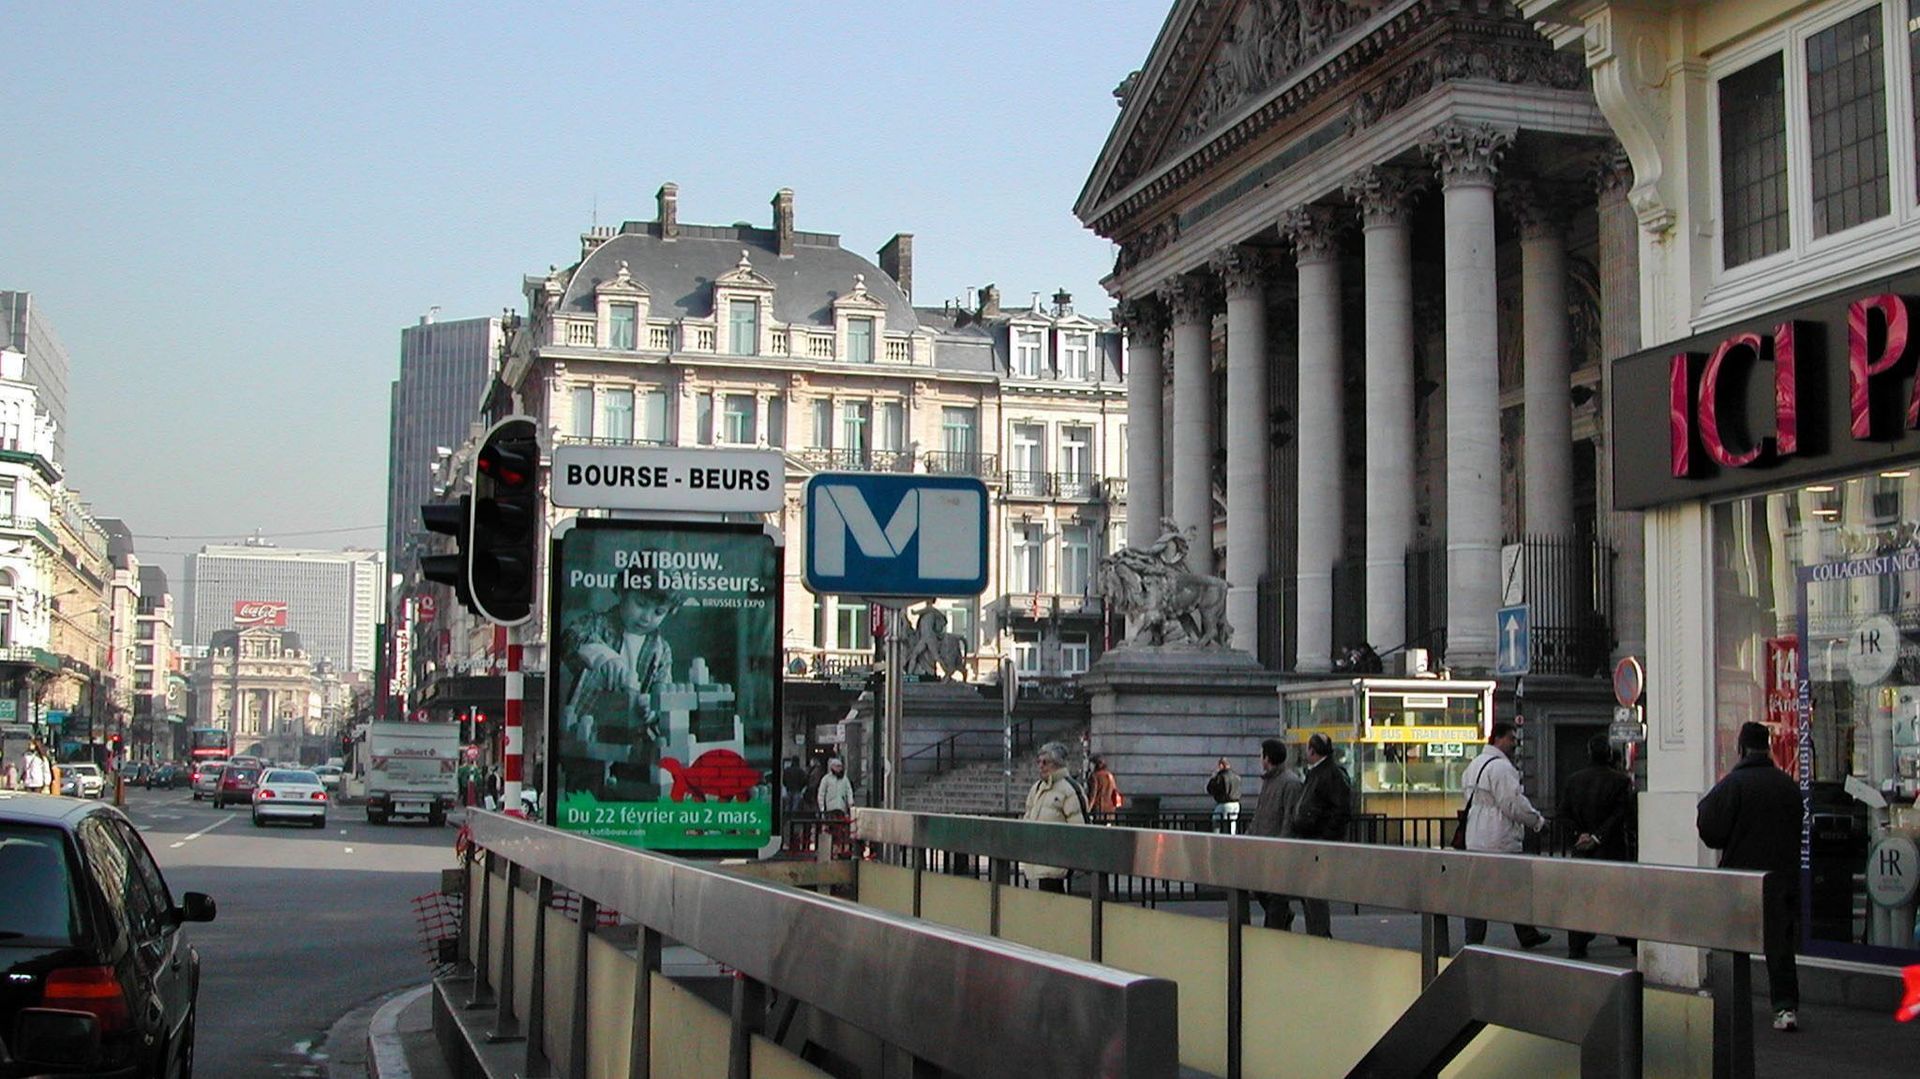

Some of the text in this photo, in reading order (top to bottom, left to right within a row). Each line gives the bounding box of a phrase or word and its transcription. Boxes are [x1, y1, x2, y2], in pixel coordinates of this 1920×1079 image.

[1670, 293, 1920, 478] ICI P
[567, 464, 668, 488] BOURSE
[690, 468, 770, 491] BEURS
[614, 550, 723, 571] BATIBOUW.
[1812, 556, 1889, 581] COLLAGENIST
[570, 569, 765, 593] Pour les bâtisseurs.
[702, 598, 765, 608] BRUSSELS EXPO
[1860, 629, 1881, 656] HR
[1799, 679, 1809, 790] RUBINSTEIN
[568, 807, 762, 824] Du 22 février au 2 mars.
[1880, 849, 1902, 876] HR
